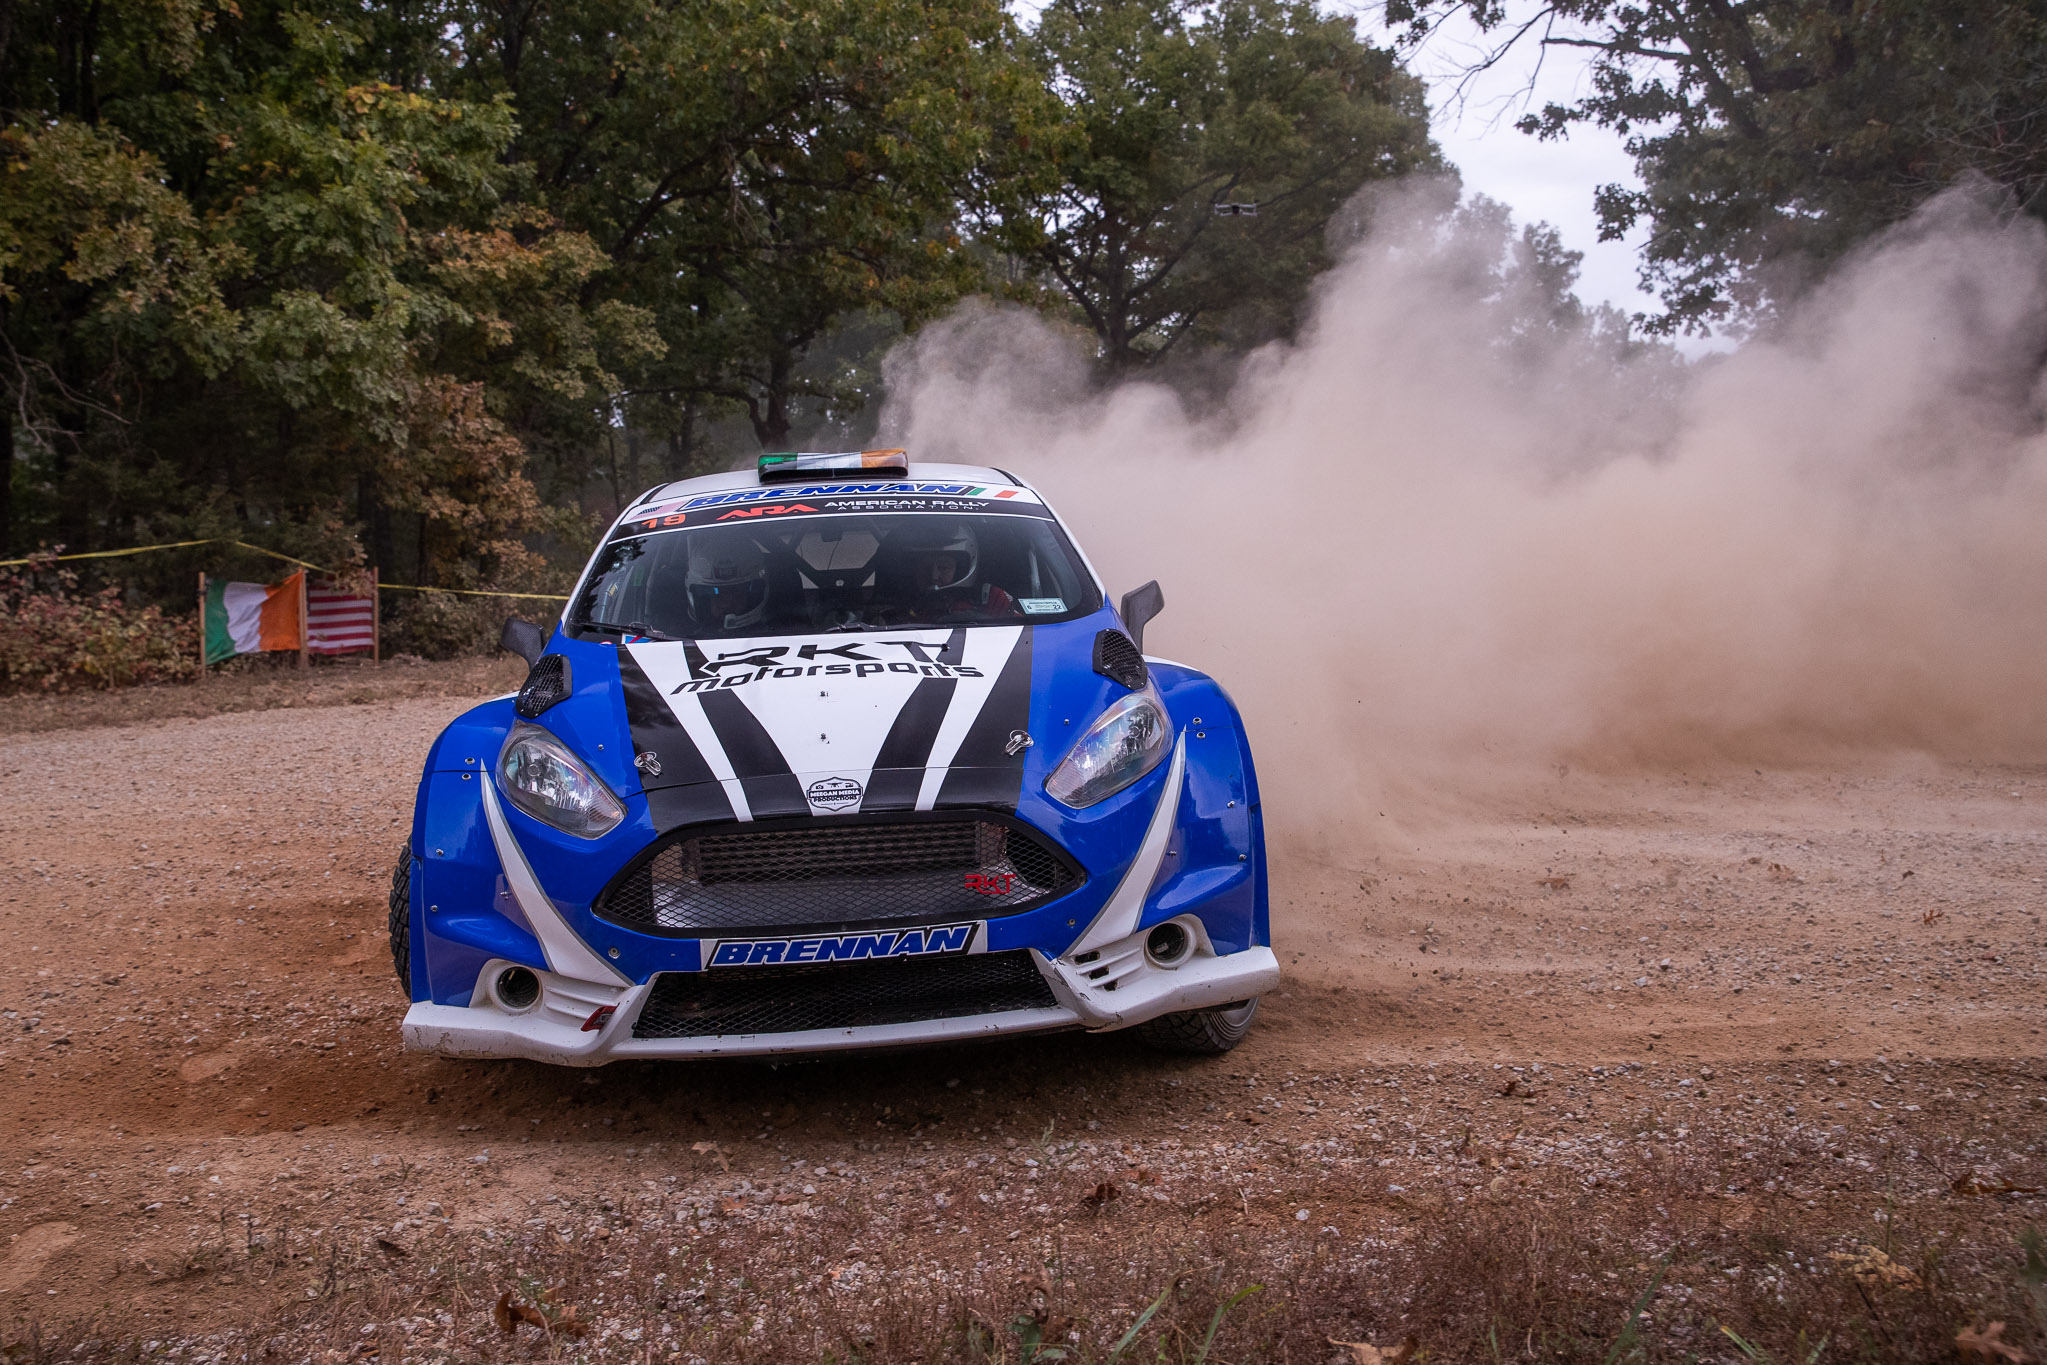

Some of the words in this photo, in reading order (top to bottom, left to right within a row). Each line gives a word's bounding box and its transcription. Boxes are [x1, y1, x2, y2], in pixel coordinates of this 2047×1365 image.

[683, 483, 966, 509] BRENNAN
[824, 499, 926, 508] AMERICAN
[931, 500, 989, 508] RALLY
[641, 513, 687, 529] 19
[715, 503, 819, 521] ARA
[700, 640, 950, 675] RKT
[669, 661, 984, 696] motorsports
[964, 873, 1016, 894] RKT
[709, 924, 974, 967] BRENNAN
